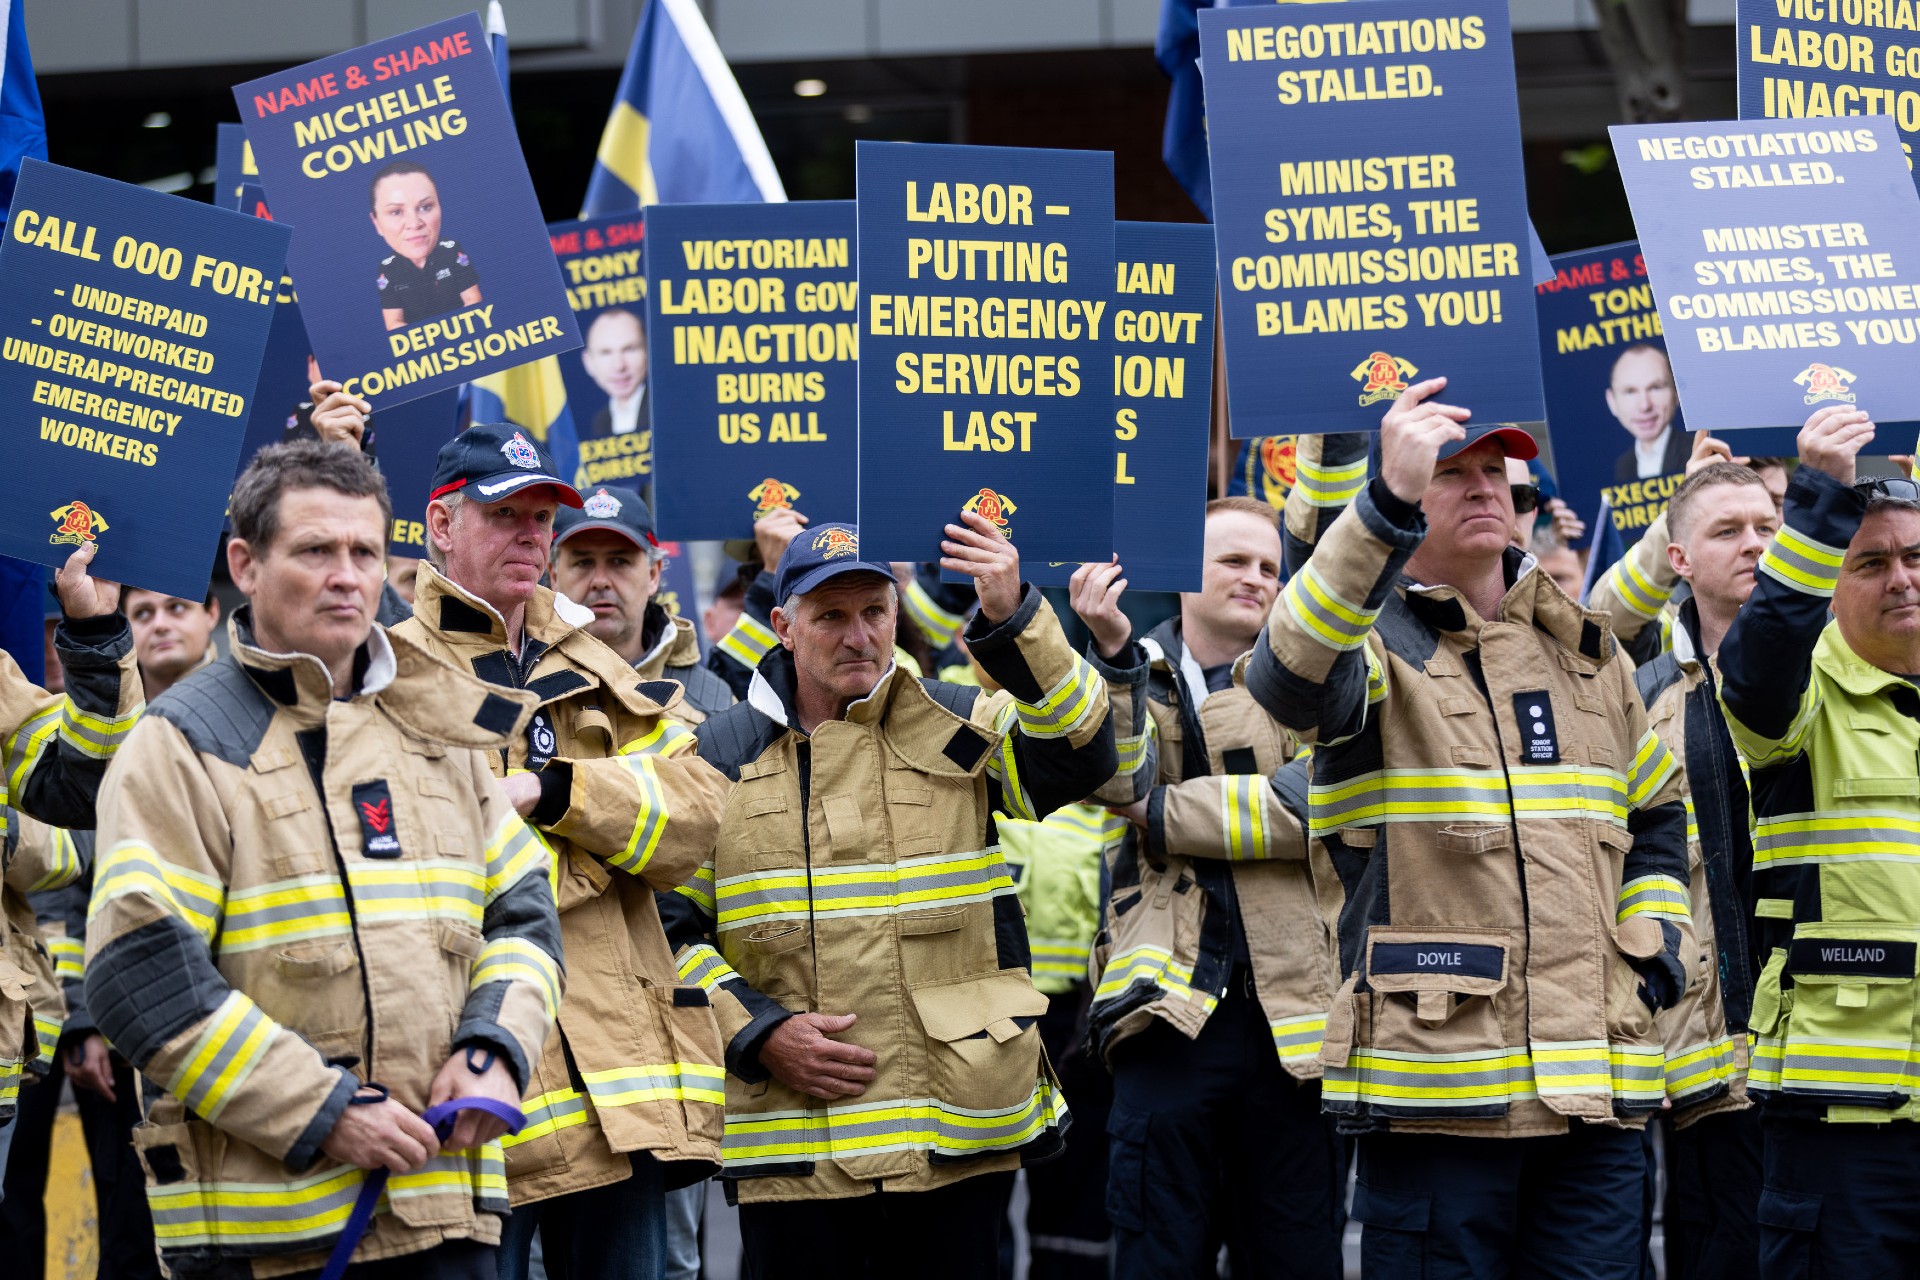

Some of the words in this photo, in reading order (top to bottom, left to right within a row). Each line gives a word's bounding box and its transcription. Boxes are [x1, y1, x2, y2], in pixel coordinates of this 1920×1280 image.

[1775, 0, 1920, 32] VICTORIA
[1227, 16, 1486, 62] NEGOTIATIONS
[1751, 25, 1875, 74] LABOR
[253, 72, 340, 118] NAME
[345, 65, 370, 91] &
[373, 31, 472, 81] SHAME
[1277, 64, 1443, 105] STALLED.
[293, 75, 456, 148] MICHELLE
[302, 108, 468, 179] COWLING
[1637, 129, 1878, 161] NEGOTIATIONS
[1279, 154, 1457, 197] MINISTER
[1690, 161, 1845, 190] STALLED.
[906, 181, 1033, 226] LABOR
[1264, 203, 1402, 244] SYMES,
[1408, 198, 1480, 235] THE
[13, 209, 101, 262] CALL
[190, 254, 274, 305] FOR:
[682, 238, 849, 270] VICTORIAN
[1702, 222, 1869, 253] MINISTER
[565, 249, 641, 284] TONY
[908, 238, 1068, 283] PUTTING
[1231, 242, 1520, 292] COMMISSIONER
[1610, 258, 1631, 281] &
[1694, 257, 1825, 286] SYMES,
[1827, 253, 1897, 280] THE
[71, 283, 208, 338] UNDERPAID
[660, 277, 786, 315] LABOR
[795, 281, 858, 312] GOV
[870, 294, 1107, 341] EMERGENCY
[1256, 294, 1408, 337] BLAMES
[1415, 289, 1502, 327] YOU!
[1589, 283, 1653, 317] TON
[49, 313, 215, 375] OVERWORKED
[388, 304, 494, 358] DEPUTY
[673, 322, 858, 365] INACTION
[1114, 309, 1203, 344] GOVT
[1696, 321, 1841, 353] BLAMES
[2, 336, 245, 418] UNDERAPPRECIATED
[342, 316, 564, 401] COMMISSIONER
[895, 352, 1081, 397] SERVICES
[32, 380, 182, 437] EMERGENCY
[717, 371, 826, 404] BURNS
[39, 416, 159, 467] WORKERS
[718, 412, 761, 444] US
[768, 411, 828, 443] ALL
[943, 410, 1037, 452] LAST
[1417, 952, 1462, 966] DOYLE
[1821, 948, 1886, 962] WELLAND
